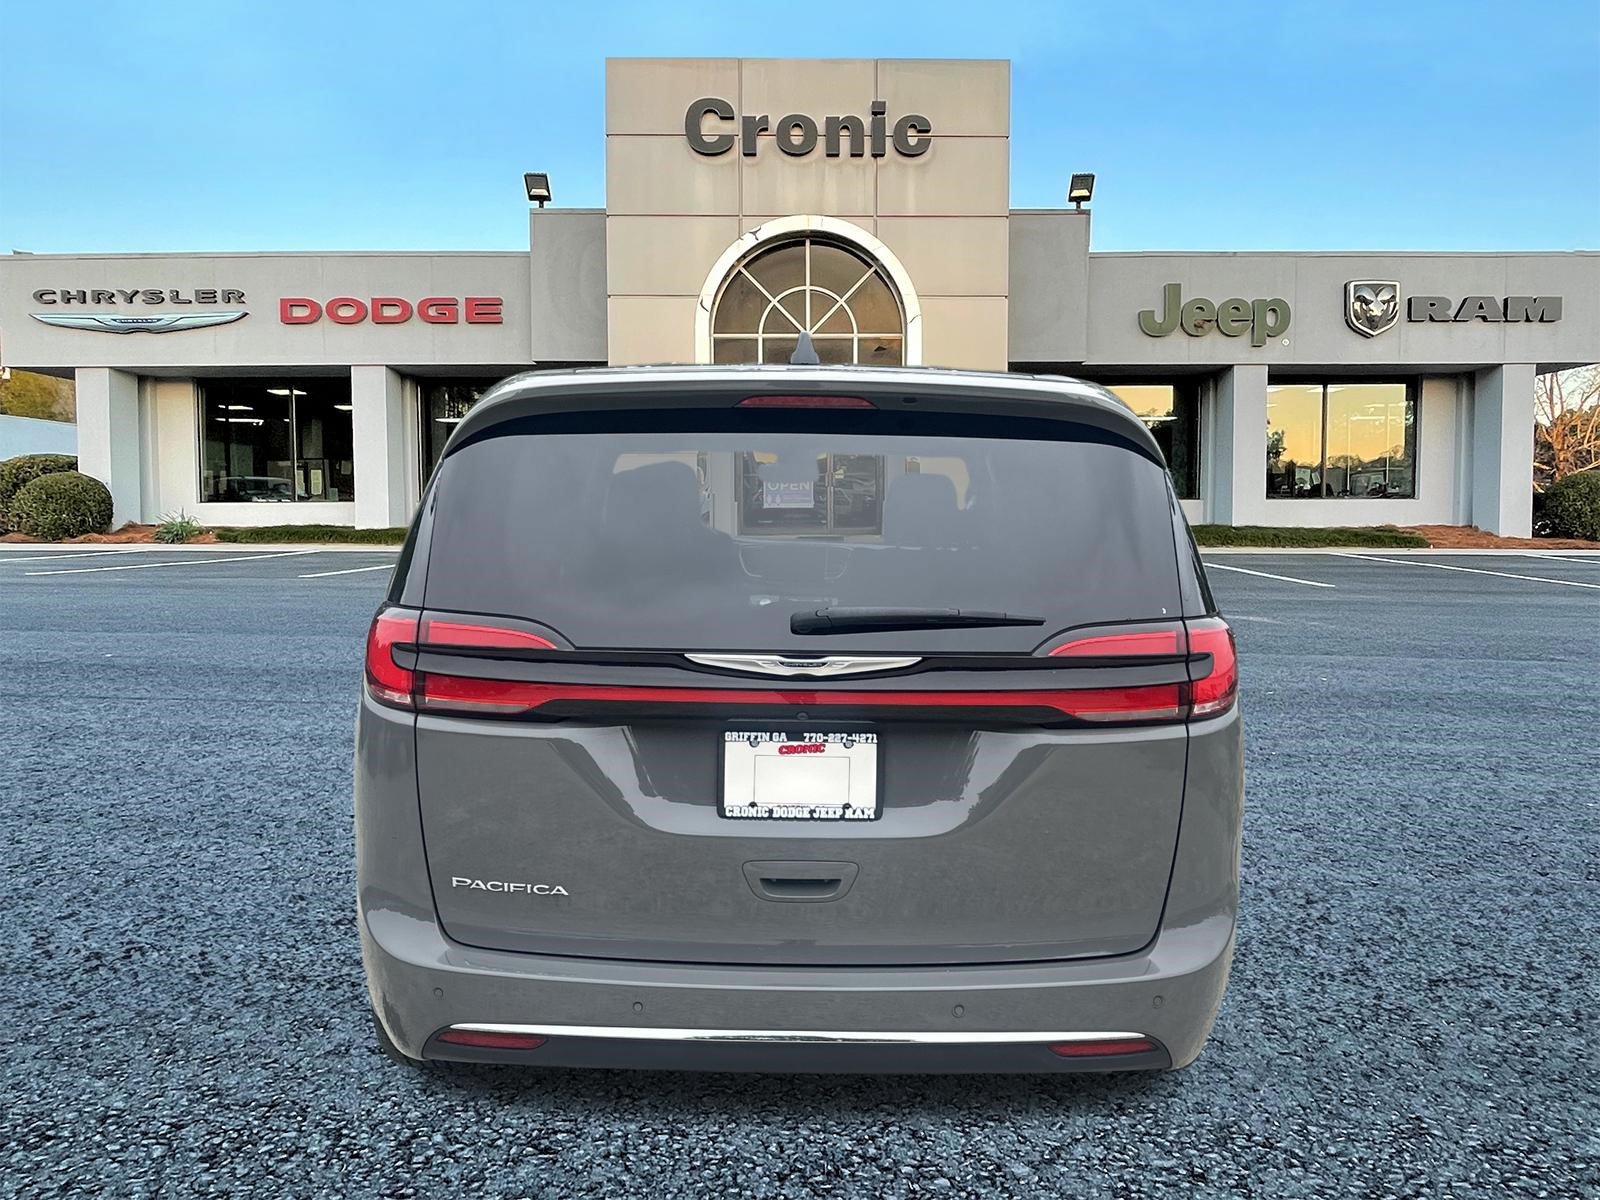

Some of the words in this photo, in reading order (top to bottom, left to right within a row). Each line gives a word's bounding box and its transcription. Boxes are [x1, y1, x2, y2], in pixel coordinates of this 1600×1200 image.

[684, 97, 932, 158] Cronic
[32, 288, 247, 304] CHRYSLER
[279, 296, 504, 325] DODGE
[1138, 282, 1292, 348] Jeep
[1407, 295, 1563, 323] RAM
[724, 731, 770, 742] GRIFFIN
[772, 732, 788, 742] GA
[803, 732, 878, 744] 770-227-4271
[778, 743, 826, 755] CRONIC
[725, 806, 770, 818] CRONIC
[772, 806, 811, 819] DODGE
[812, 807, 844, 819] JEEP
[844, 807, 876, 820] RAM
[451, 876, 569, 896] PACIFICA
